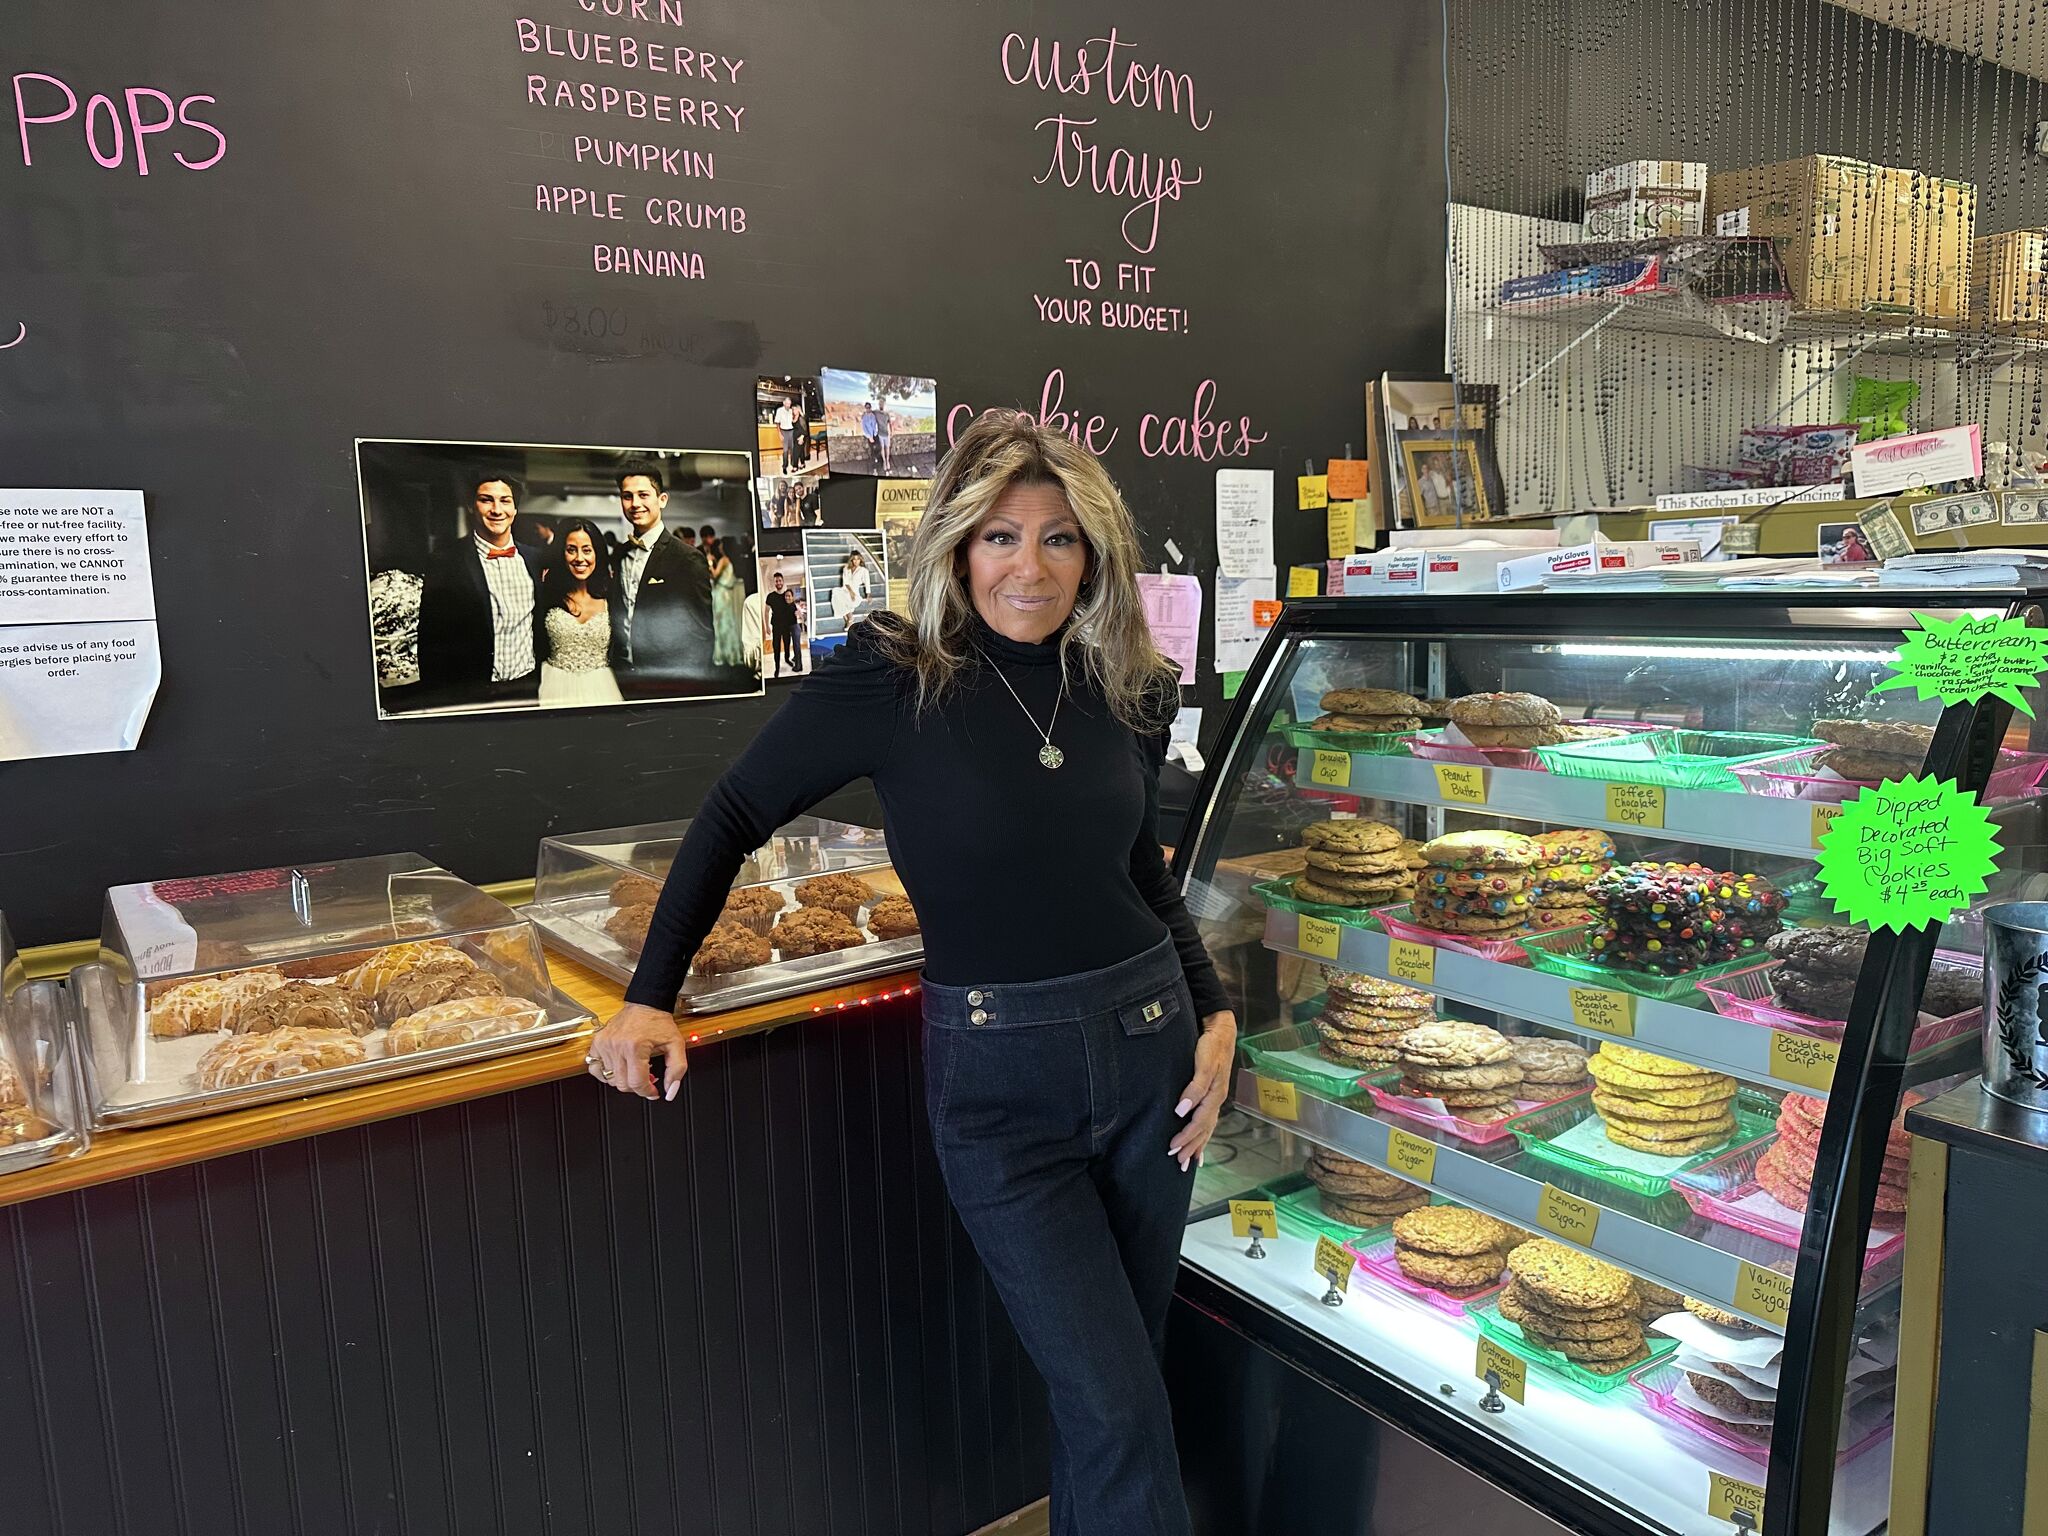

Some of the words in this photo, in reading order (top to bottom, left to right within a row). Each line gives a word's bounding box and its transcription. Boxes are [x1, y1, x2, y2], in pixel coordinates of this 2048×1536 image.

[577, 0, 684, 27] CORN
[516, 18, 745, 84] BLUEBERRY
[1001, 27, 1213, 131] custom
[526, 74, 746, 133] RASPBERRY
[12, 73, 228, 176] POPS
[574, 136, 715, 180] PUMPKIN
[1033, 113, 1202, 254] trays
[536, 184, 626, 220] APPLE
[645, 198, 747, 234] CRUMB
[593, 244, 706, 280] BANANA
[1065, 258, 1101, 290] TO
[1118, 263, 1156, 293] FIT
[1034, 294, 1091, 326] YOUR
[1101, 301, 1189, 334] BUDGET!
[1139, 379, 1268, 462] cakes
[1659, 497, 1687, 509] This
[1690, 493, 1737, 508] Kitchen
[1742, 493, 1753, 505] Is
[1757, 492, 1780, 504] For
[1784, 490, 1842, 503] Dancing
[14, 507, 39, 516] note
[42, 508, 58, 516] we
[61, 508, 79, 516] are
[82, 507, 104, 515] NOT
[27, 521, 39, 529] or
[42, 520, 84, 529] nut-free
[87, 520, 126, 530] facility.
[18, 534, 50, 542] make
[53, 534, 82, 543] every
[85, 534, 115, 542] effort
[117, 534, 128, 542] to
[22, 548, 51, 556] there
[54, 547, 64, 555] is
[83, 547, 115, 555] cross-
[1547, 555, 1563, 564] Poly
[1564, 550, 1589, 560] Gloves
[80, 560, 124, 568] CANNOT
[11, 574, 68, 585] guarantee
[70, 573, 98, 582] there
[101, 573, 111, 581] is
[113, 573, 127, 581] no
[1959, 621, 1998, 636] Add
[23, 643, 58, 652] advise
[77, 641, 87, 649] of
[90, 641, 108, 649] any
[112, 639, 135, 647] food
[1925, 634, 2037, 651] Buttercream
[35, 655, 69, 664] before
[73, 653, 111, 664] placing
[114, 653, 136, 661] your
[1965, 652, 1996, 663] extra
[48, 669, 79, 677] order.
[1915, 663, 1953, 671] vanilla
[1915, 669, 1961, 677] chocolate
[1442, 769, 1472, 782] Peanut
[1451, 783, 1481, 798] Butter
[1612, 786, 1654, 798] Toffee
[1615, 798, 1657, 809] Chocolate
[1876, 792, 1943, 823] Dipped
[1620, 808, 1646, 824] Chip
[1861, 817, 1949, 843] Decorated
[1858, 847, 1891, 874] Big
[1900, 837, 1958, 856] Soft
[1864, 862, 1950, 886] Cookies
[1929, 885, 1964, 902] each
[1306, 921, 1337, 935] Chocolate
[1306, 934, 1324, 947] Chip
[1395, 958, 1431, 970] Chocolate
[1397, 967, 1416, 980] Chip
[1575, 991, 1608, 1002] Double
[1575, 1000, 1622, 1011] Chocolate
[1582, 1009, 1606, 1021] Chip
[1778, 1033, 1821, 1050] Double
[1777, 1043, 1835, 1063] Chocolate
[1785, 1053, 1816, 1067] Chip
[1394, 1133, 1433, 1155] Cinnamon
[1397, 1149, 1424, 1169] Sugar
[1548, 1189, 1587, 1216] Lemon
[1234, 1204, 1274, 1221] Gingersnap
[1549, 1206, 1585, 1229] Sugar
[1481, 1342, 1515, 1369] Oatmeal
[1487, 1358, 1522, 1383] Chocolate
[1719, 1476, 1766, 1499] Oatmea
[1724, 1488, 1761, 1512] Raisi
